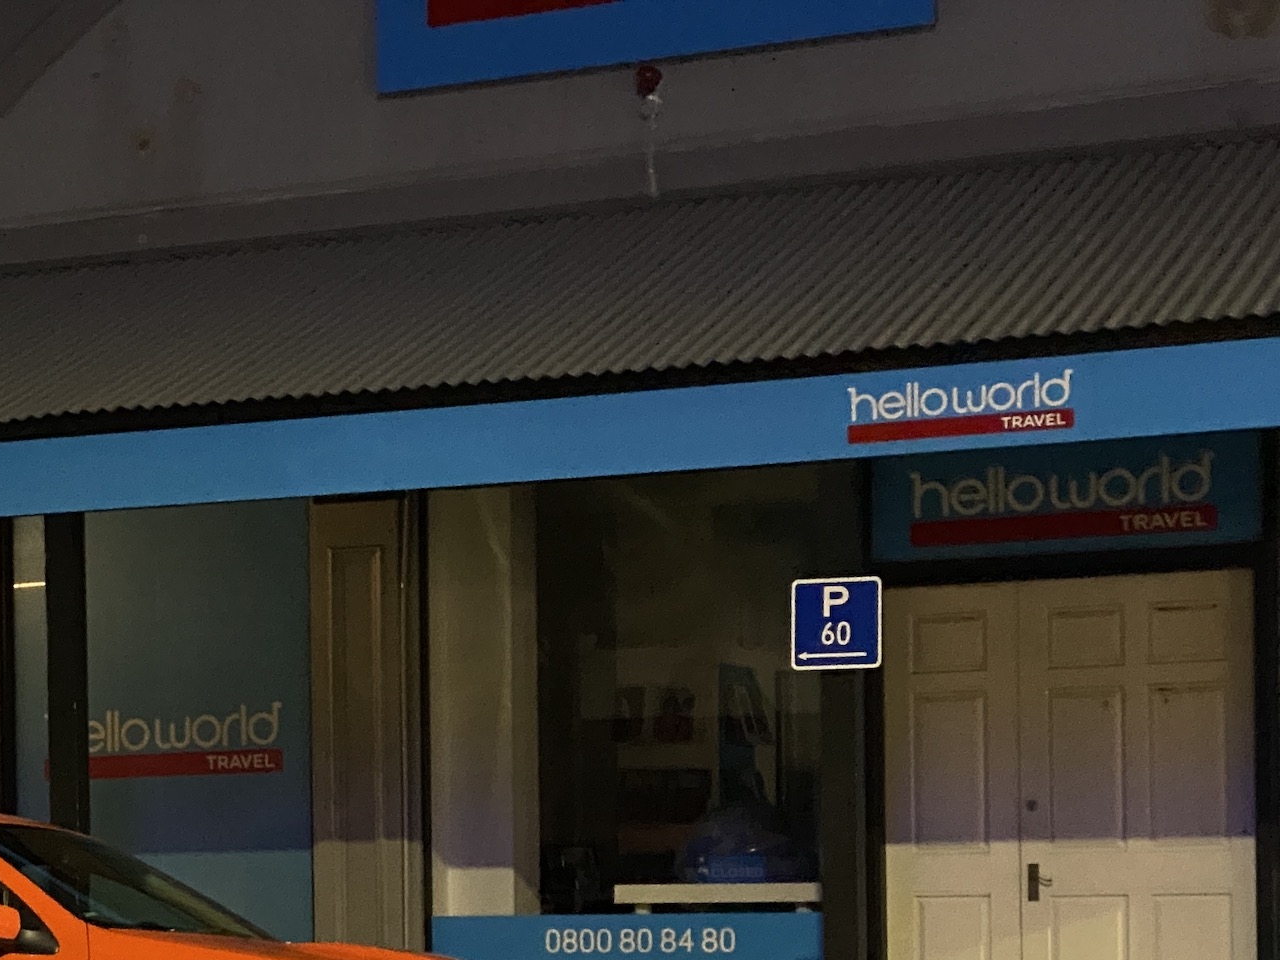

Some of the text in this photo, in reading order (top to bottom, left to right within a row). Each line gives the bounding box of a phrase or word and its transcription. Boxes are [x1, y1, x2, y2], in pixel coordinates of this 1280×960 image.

[847, 368, 1073, 422] helloworld
[1001, 412, 1067, 430] TRAVEL
[909, 449, 1214, 519] helloworld
[1120, 510, 1208, 532] TRAVEL
[823, 585, 850, 618] P
[821, 621, 851, 646] 60
[88, 701, 282, 752] elloworld
[206, 753, 275, 770] TRAVEL
[545, 927, 736, 953] 0800 80 84 80
